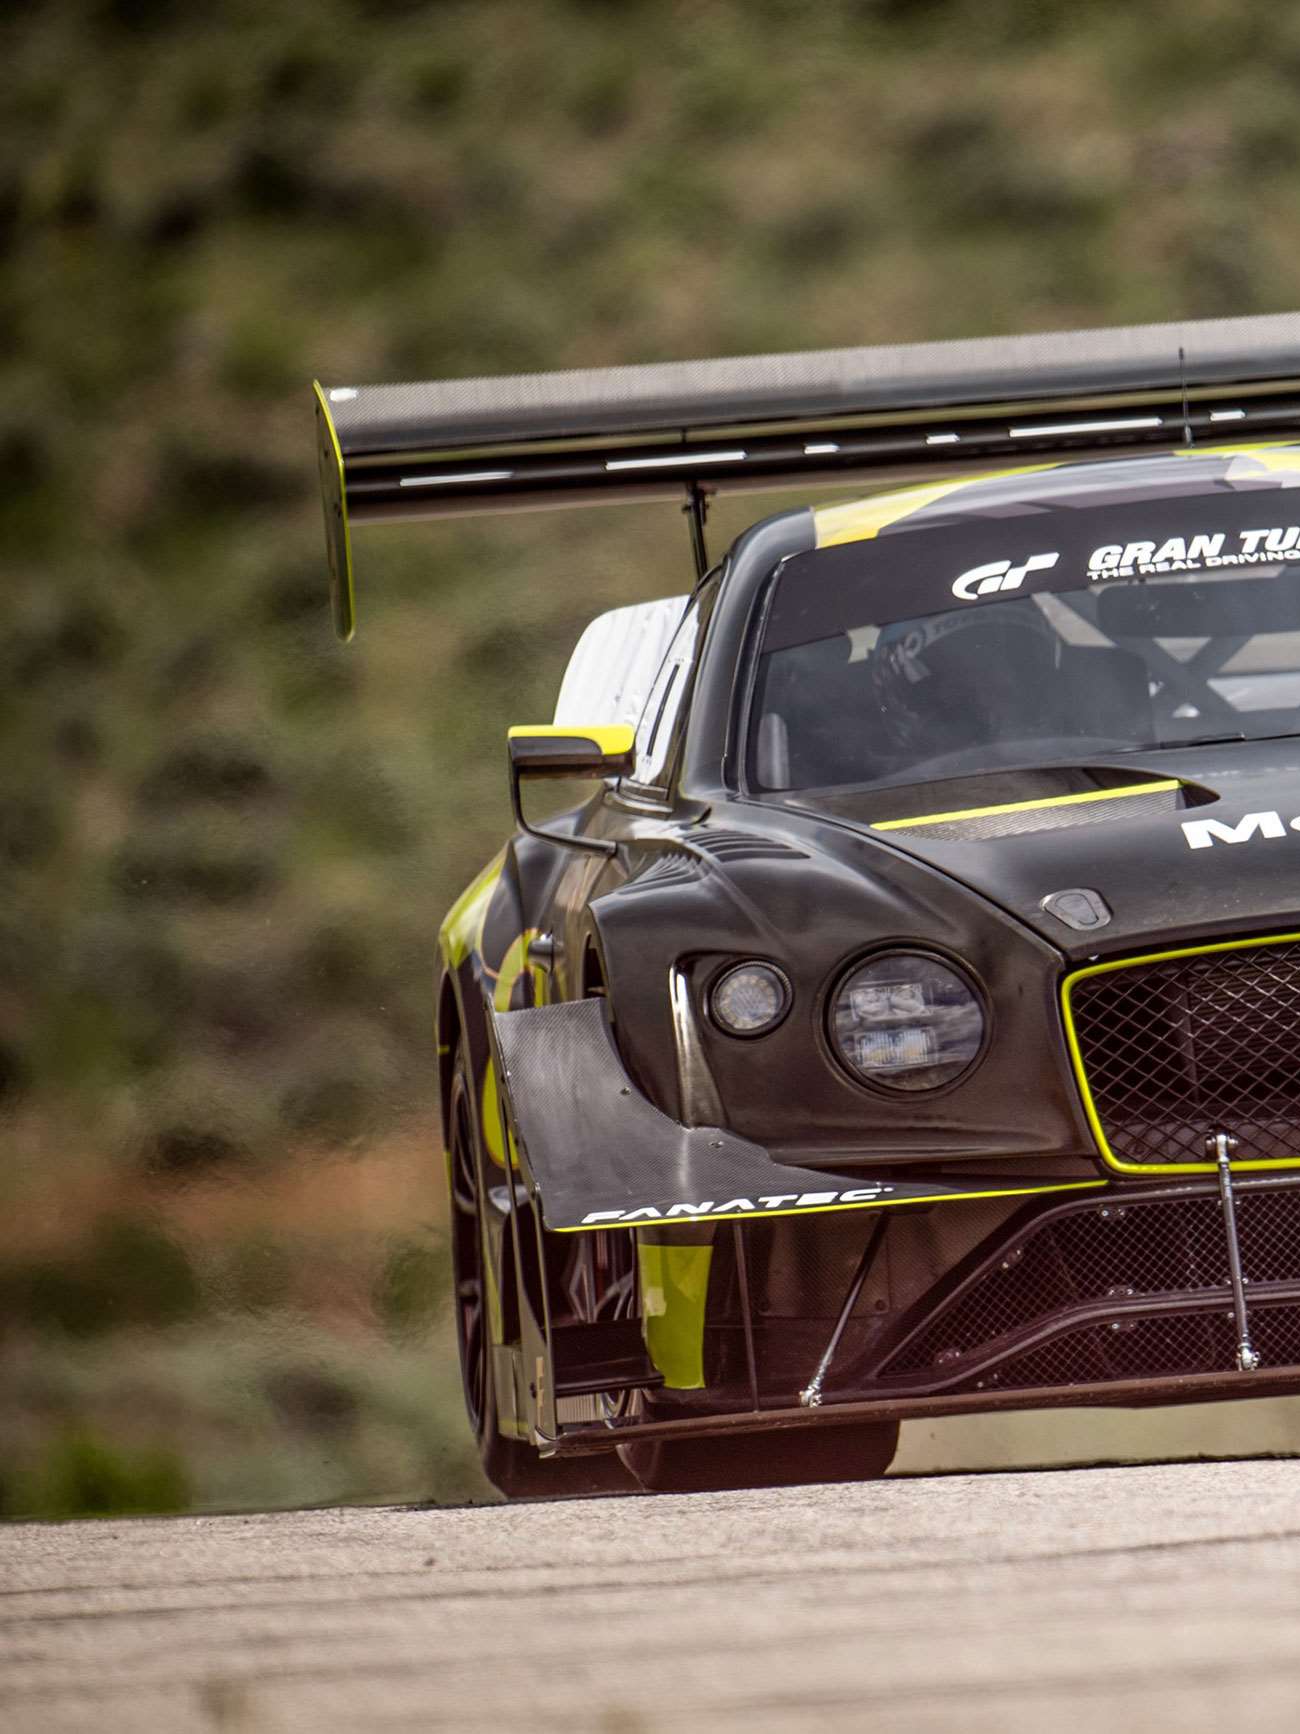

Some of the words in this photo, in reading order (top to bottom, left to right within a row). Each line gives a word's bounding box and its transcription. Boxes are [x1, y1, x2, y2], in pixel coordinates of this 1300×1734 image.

[1086, 566, 1135, 581] THE
[1139, 560, 1201, 574] REAL
[1088, 534, 1226, 571] GRAN
[581, 1188, 882, 1224] FANATEC
